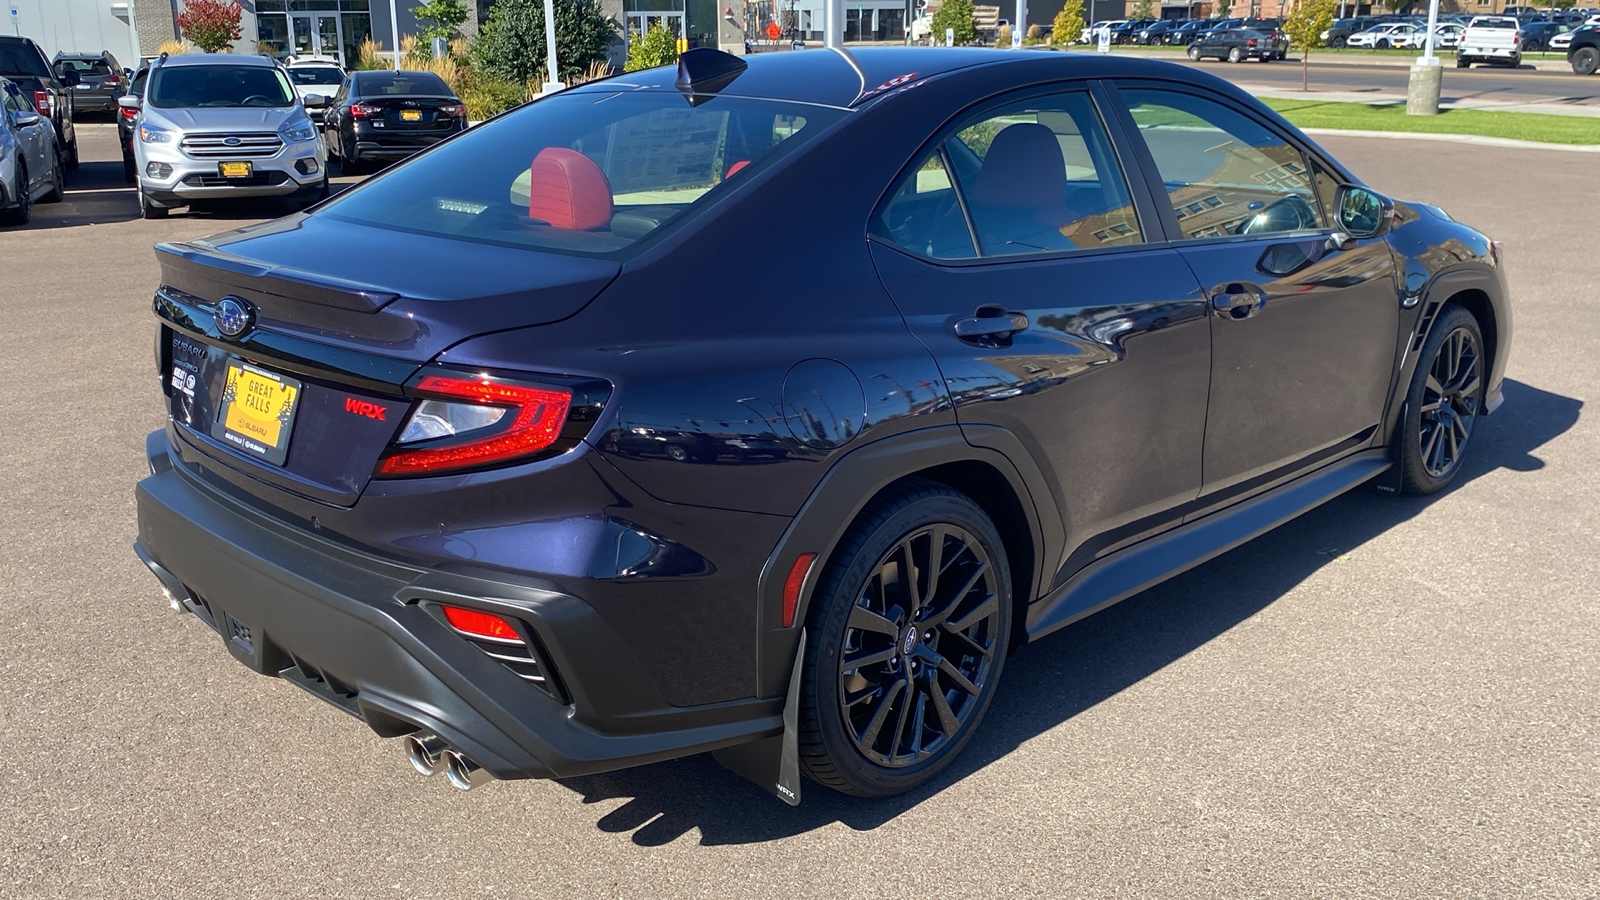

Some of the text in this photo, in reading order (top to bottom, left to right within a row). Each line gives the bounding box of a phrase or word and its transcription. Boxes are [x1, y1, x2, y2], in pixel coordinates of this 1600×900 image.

[173, 338, 205, 359] SUBARU
[248, 380, 274, 399] GREAT
[245, 393, 271, 414] FALLS
[345, 397, 387, 421] WRX
[244, 422, 267, 436] SUBARU
[775, 782, 795, 799] WRX
